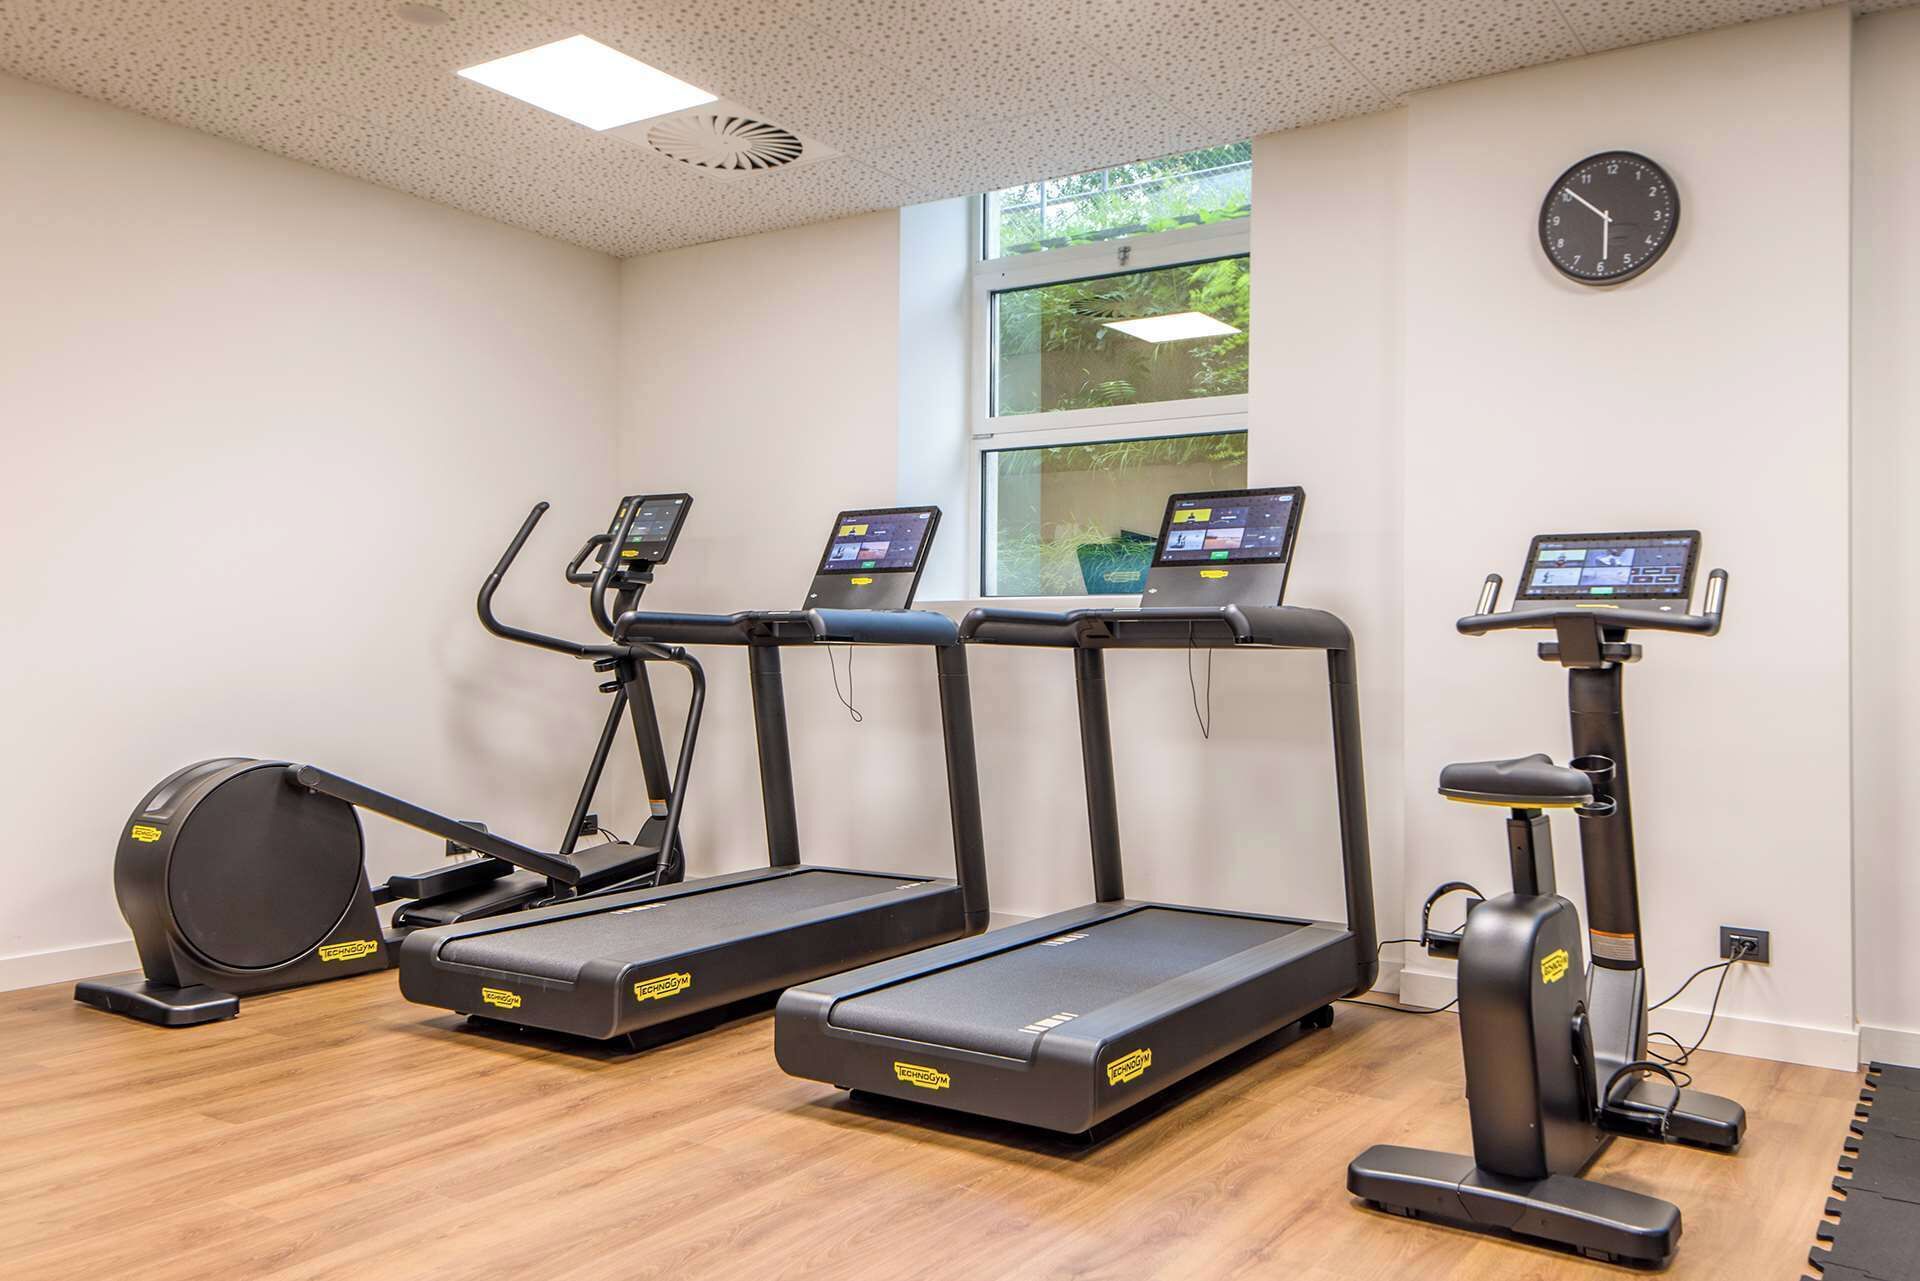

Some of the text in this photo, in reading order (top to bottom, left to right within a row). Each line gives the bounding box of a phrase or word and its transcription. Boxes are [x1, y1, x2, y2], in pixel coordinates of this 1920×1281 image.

[1606, 164, 1619, 175] 12
[1581, 174, 1592, 184] 11
[1635, 171, 1641, 180] 1
[1648, 186, 1657, 197] 2
[1552, 215, 1561, 226] 9
[1653, 210, 1662, 221] 3
[1556, 238, 1565, 248] 8
[1644, 234, 1653, 245] 4
[1573, 255, 1581, 265] 7
[1623, 253, 1632, 264] 5
[1596, 261, 1605, 272] 6
[320, 941, 376, 959] TECHNOGYM
[636, 975, 690, 998] TECHNOGYM
[1108, 1052, 1150, 1081] TECHNOGYM
[895, 1064, 949, 1086] TECHNOGYM
